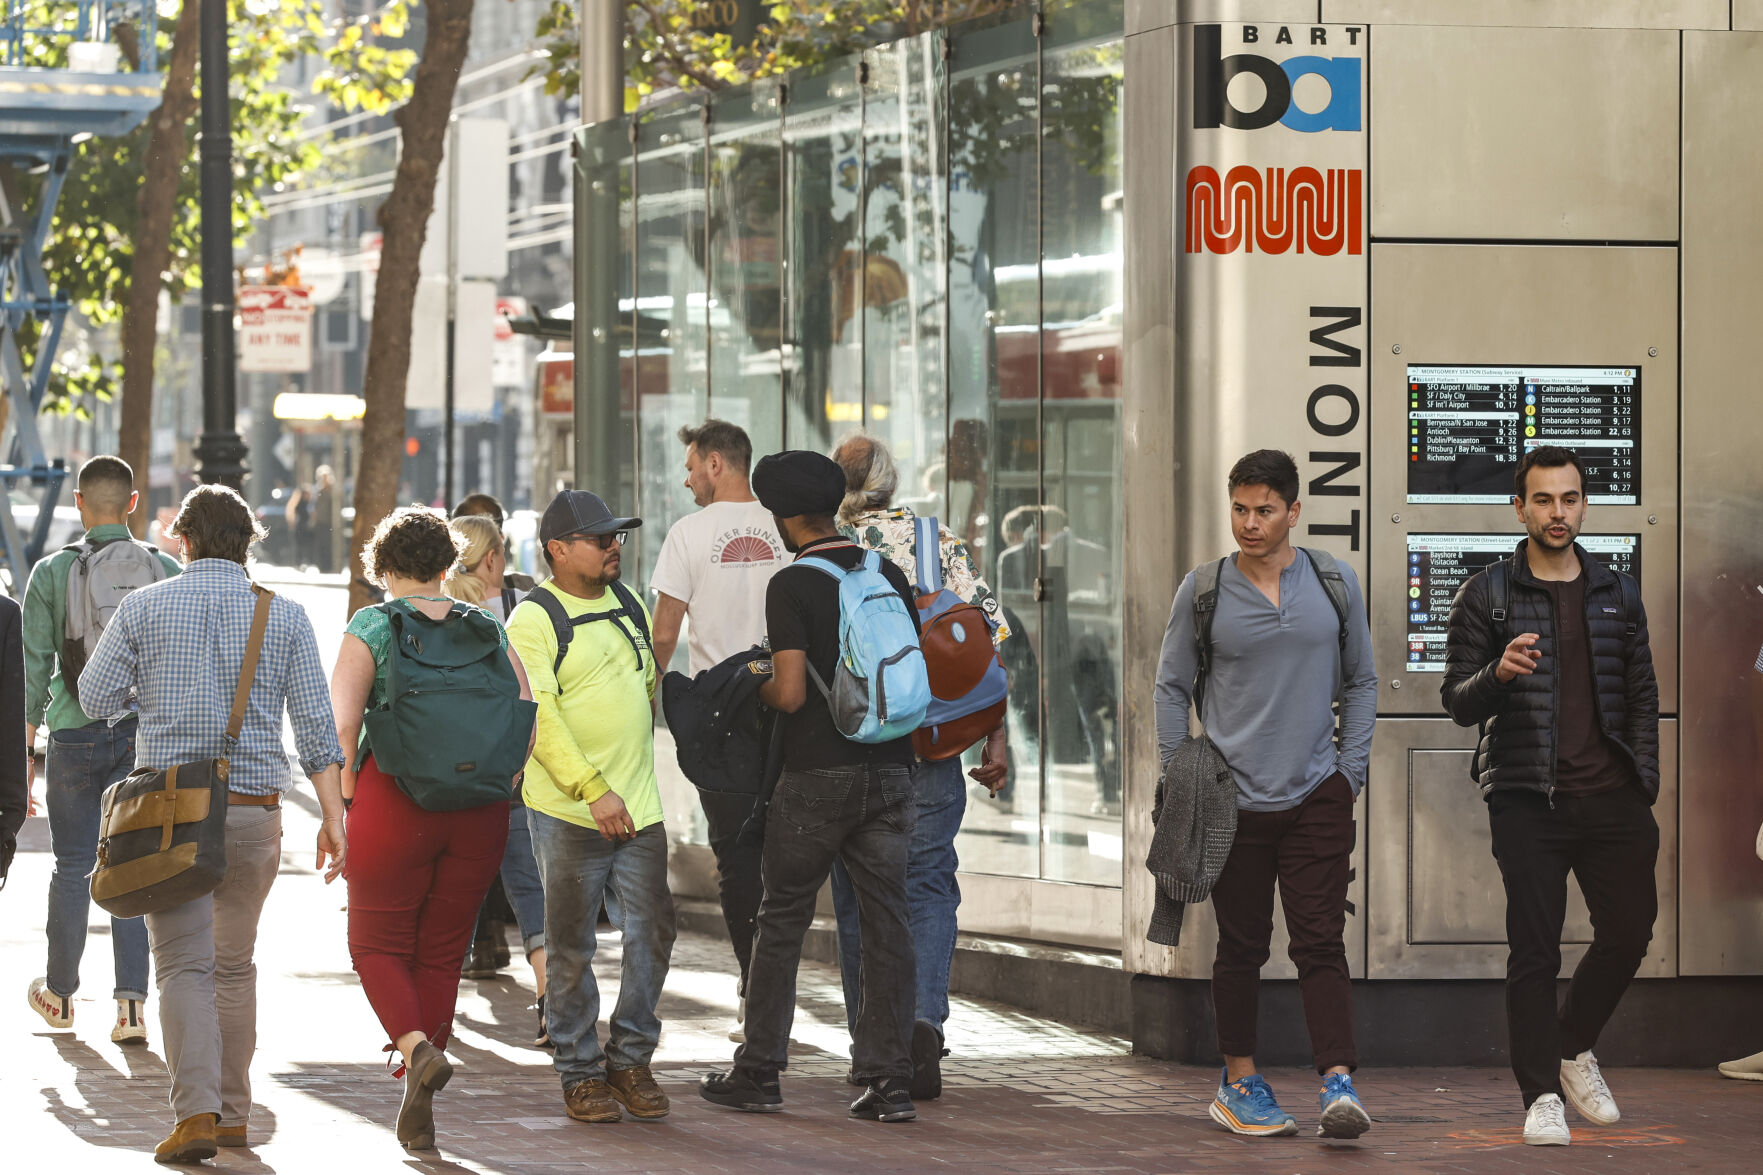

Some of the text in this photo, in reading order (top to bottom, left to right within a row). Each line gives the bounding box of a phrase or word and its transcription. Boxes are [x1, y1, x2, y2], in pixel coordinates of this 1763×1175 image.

[1243, 25, 1361, 45] BART
[1185, 165, 1362, 256] MUNI
[710, 526, 782, 564] OUTER SUNSET
